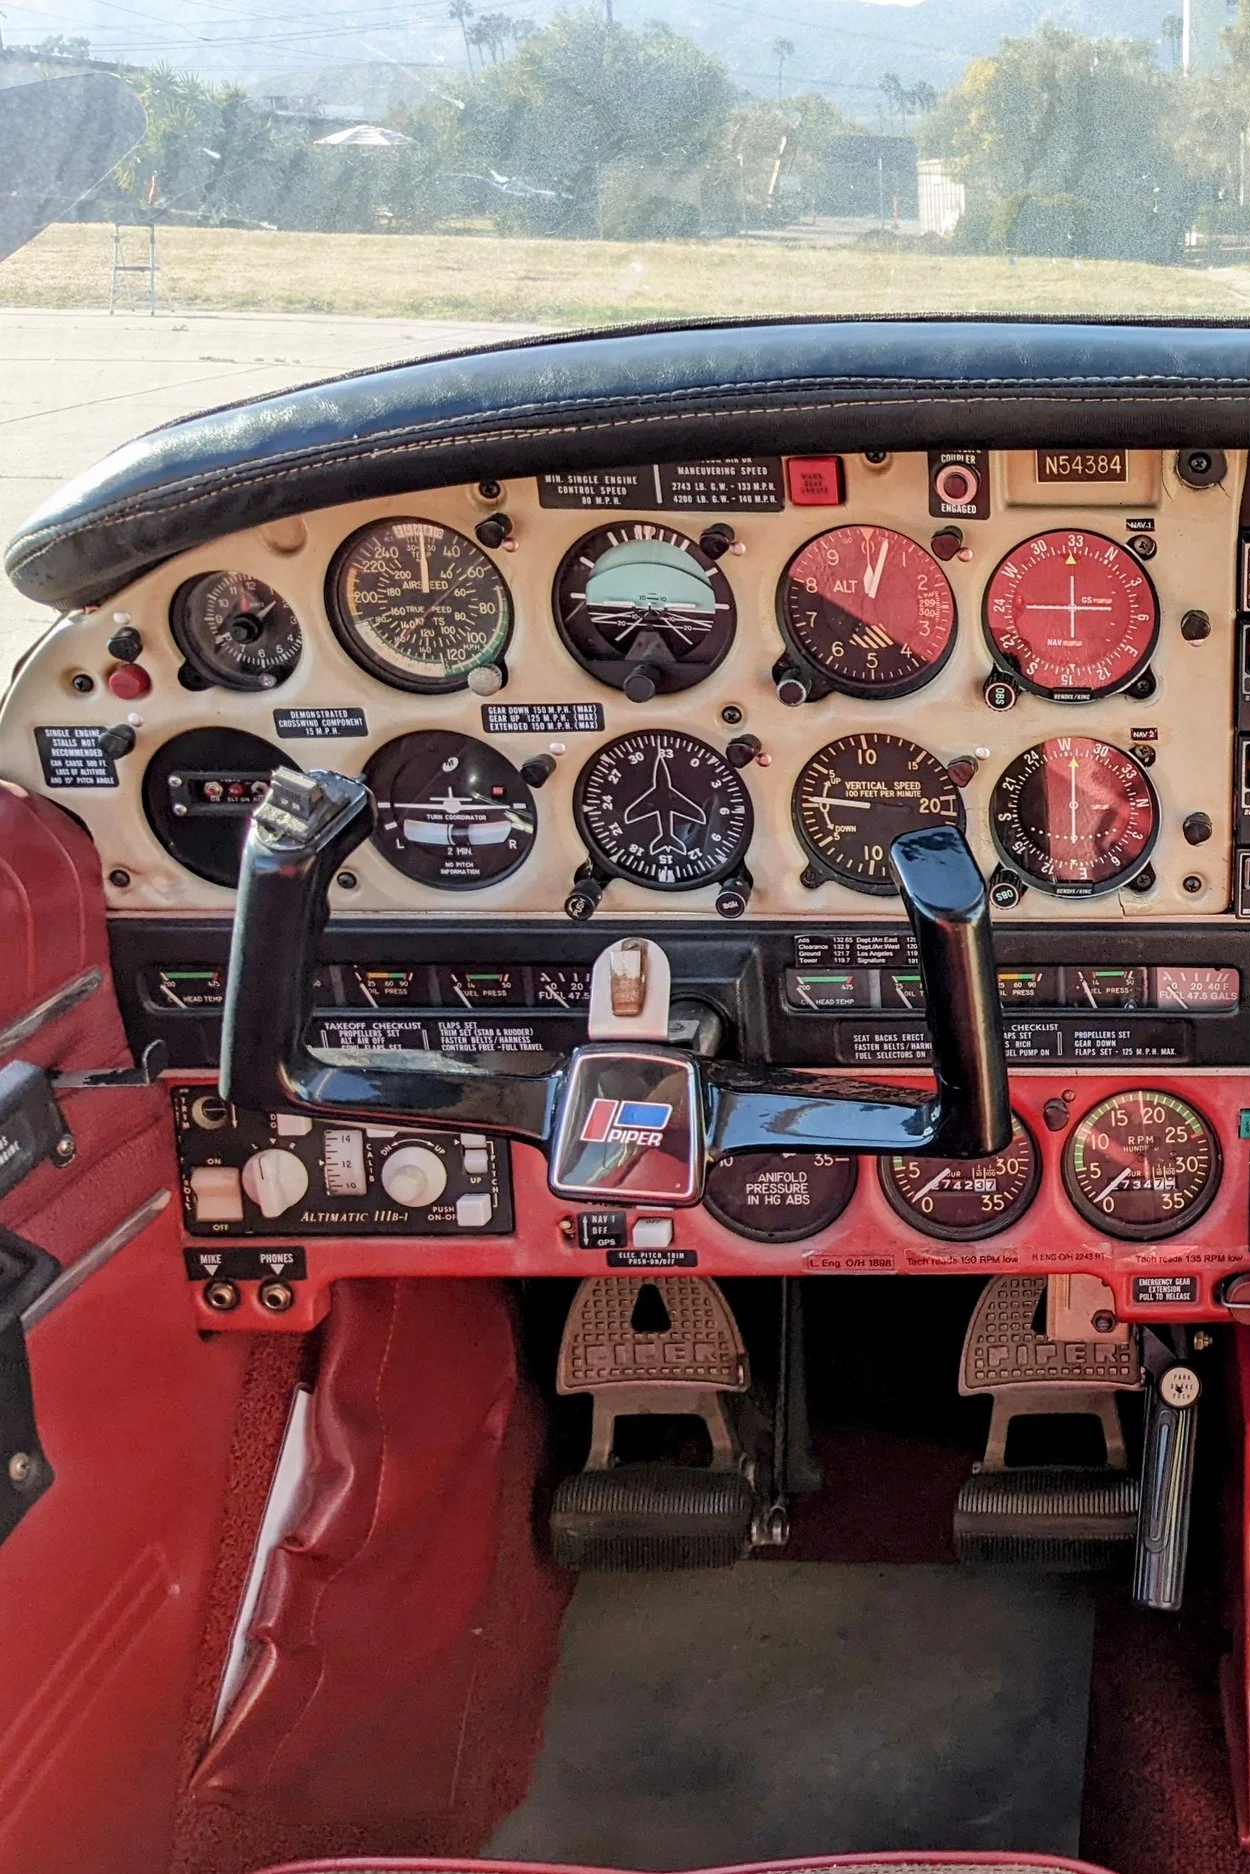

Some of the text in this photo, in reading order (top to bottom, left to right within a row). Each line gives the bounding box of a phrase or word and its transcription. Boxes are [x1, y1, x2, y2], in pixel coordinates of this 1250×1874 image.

[1046, 455, 1121, 475] N54384
[546, 475, 638, 485] MIN. SINGLE ENGINE
[558, 486, 627, 495] CONTROL SPEED
[941, 504, 977, 514] ENGAGED
[833, 580, 858, 593] ALT
[290, 711, 348, 719] DEMONSTRATED
[488, 705, 597, 715] GEAR DOWN 150 M.P.H. (MAX)
[278, 718, 363, 727] CROSSWIND COMPONENT
[489, 713, 598, 722] GEAR UP 125 M.P.H. (MAX)
[490, 721, 598, 731] EXTENDED 150 M.P.H. (MAX)
[45, 729, 100, 737] SINGLE ENGINE
[52, 749, 103, 757] RECOMMENDED
[857, 748, 877, 765] 10
[845, 781, 921, 790] VERTICAL SPEED
[920, 798, 940, 813] 20
[863, 846, 883, 861] 10
[1208, 992, 1238, 1001] GALS
[324, 1022, 366, 1030] TAKEOFF
[606, 1129, 662, 1147] PIPER
[746, 1183, 809, 1195] PRESSURE
[300, 1210, 368, 1223] ALTIMATIC
[200, 1252, 294, 1264] MIKE PHONES
[1139, 1277, 1191, 1286] EMERGENCY GEAR
[1148, 1285, 1182, 1293] EXTENSION
[1165, 1292, 1191, 1300] RELEASE
